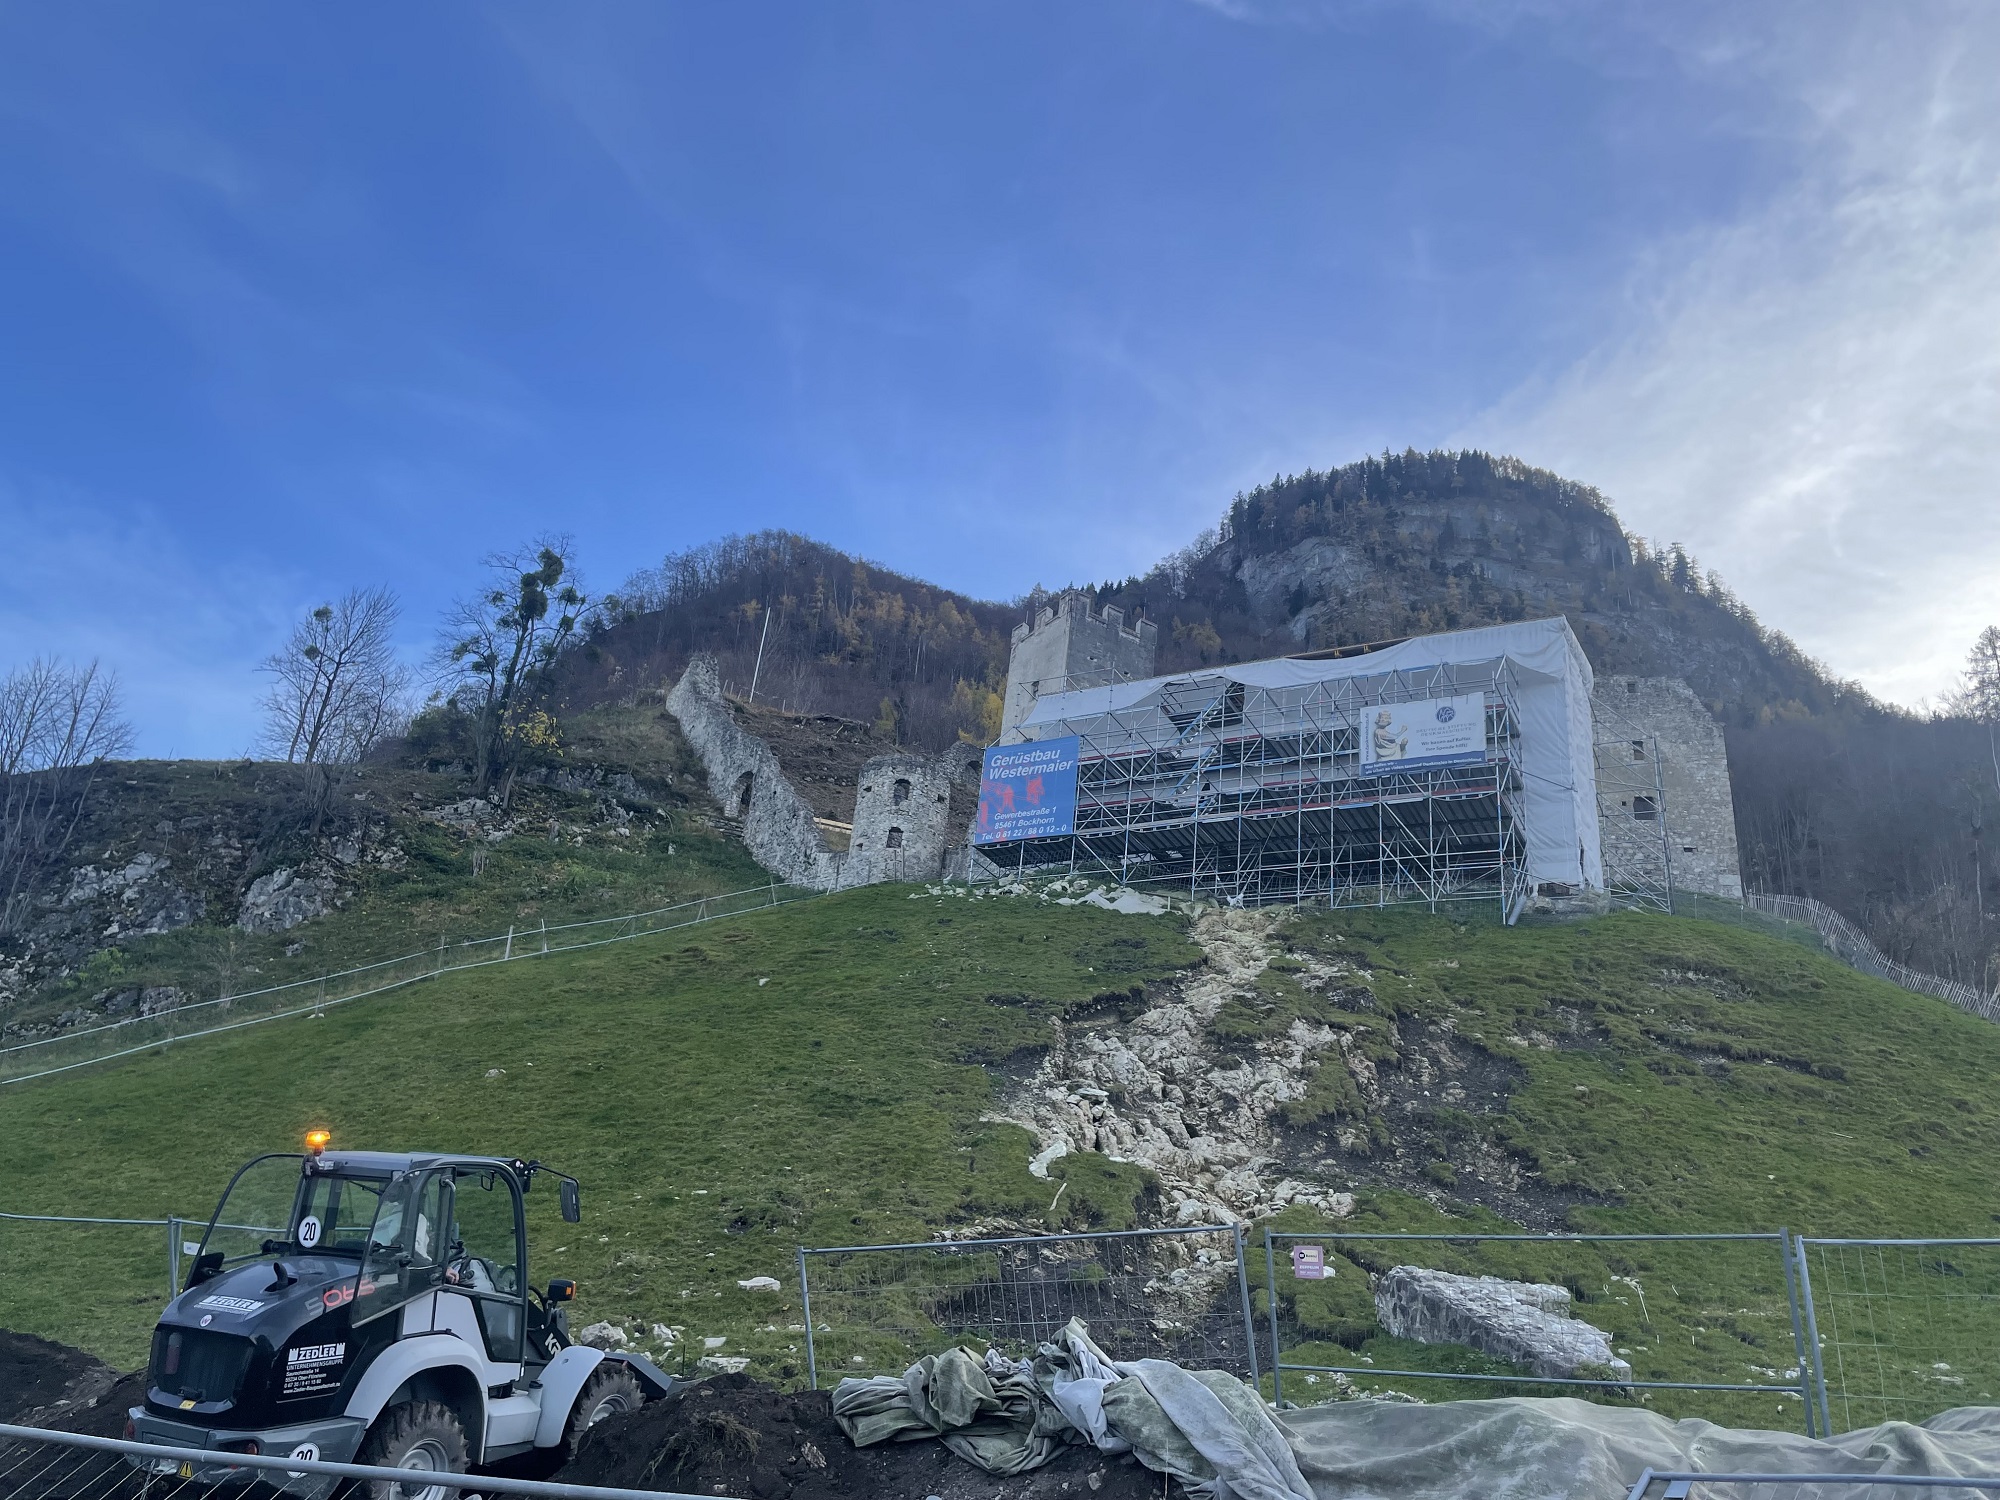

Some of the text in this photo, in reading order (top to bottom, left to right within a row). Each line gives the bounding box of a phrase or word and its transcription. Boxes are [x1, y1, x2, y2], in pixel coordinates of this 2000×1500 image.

[991, 750, 1060, 767] Gerüstbau
[989, 760, 1074, 780] Westermaier
[994, 807, 1050, 820] Gewerbestraße
[994, 817, 1054, 829] 85461 Bockhorn
[303, 1222, 316, 1241] 20
[212, 1298, 252, 1308] ZEDLER
[298, 1345, 336, 1360] ZEDLER
[286, 1359, 343, 1371] UNTERNEHMENSGRUPPE
